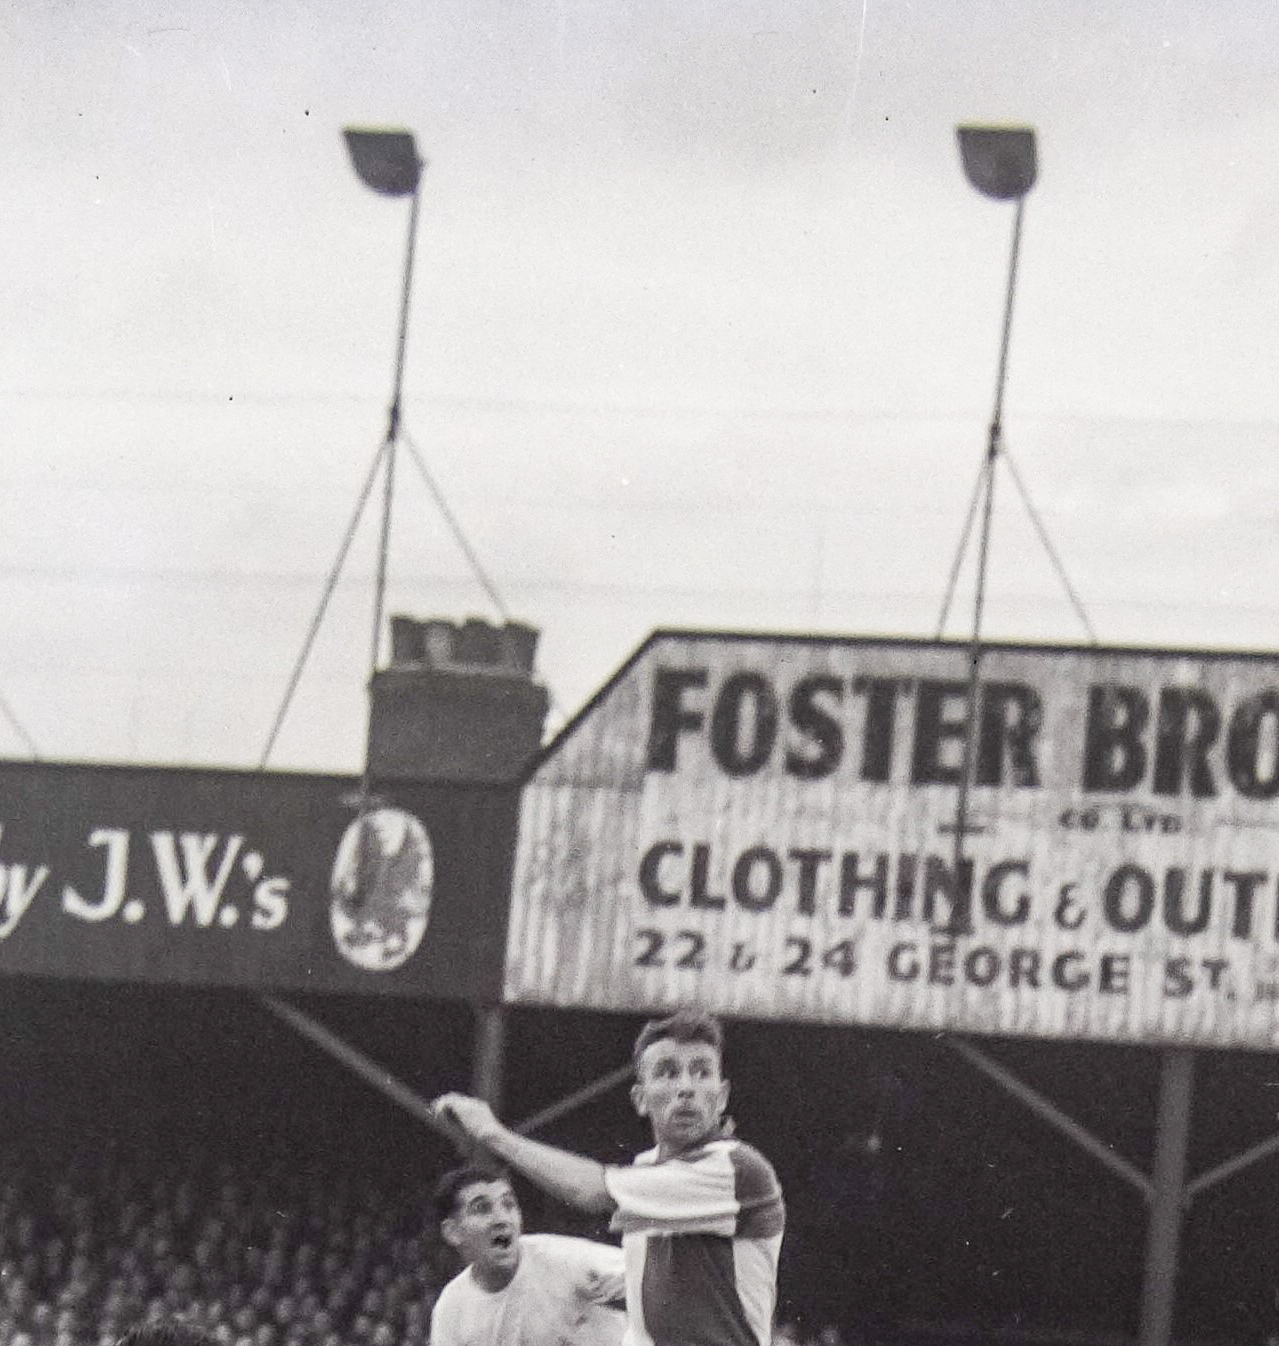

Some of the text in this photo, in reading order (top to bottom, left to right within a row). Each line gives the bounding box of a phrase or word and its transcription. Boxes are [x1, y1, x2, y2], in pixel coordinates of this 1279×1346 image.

[647, 667, 1042, 788] FOSTER
[638, 840, 1032, 934] CLOTHING
[1054, 882, 1086, 931] &
[634, 928, 707, 970] 22
[782, 937, 858, 979] 24
[886, 940, 1130, 995] GEORGE
